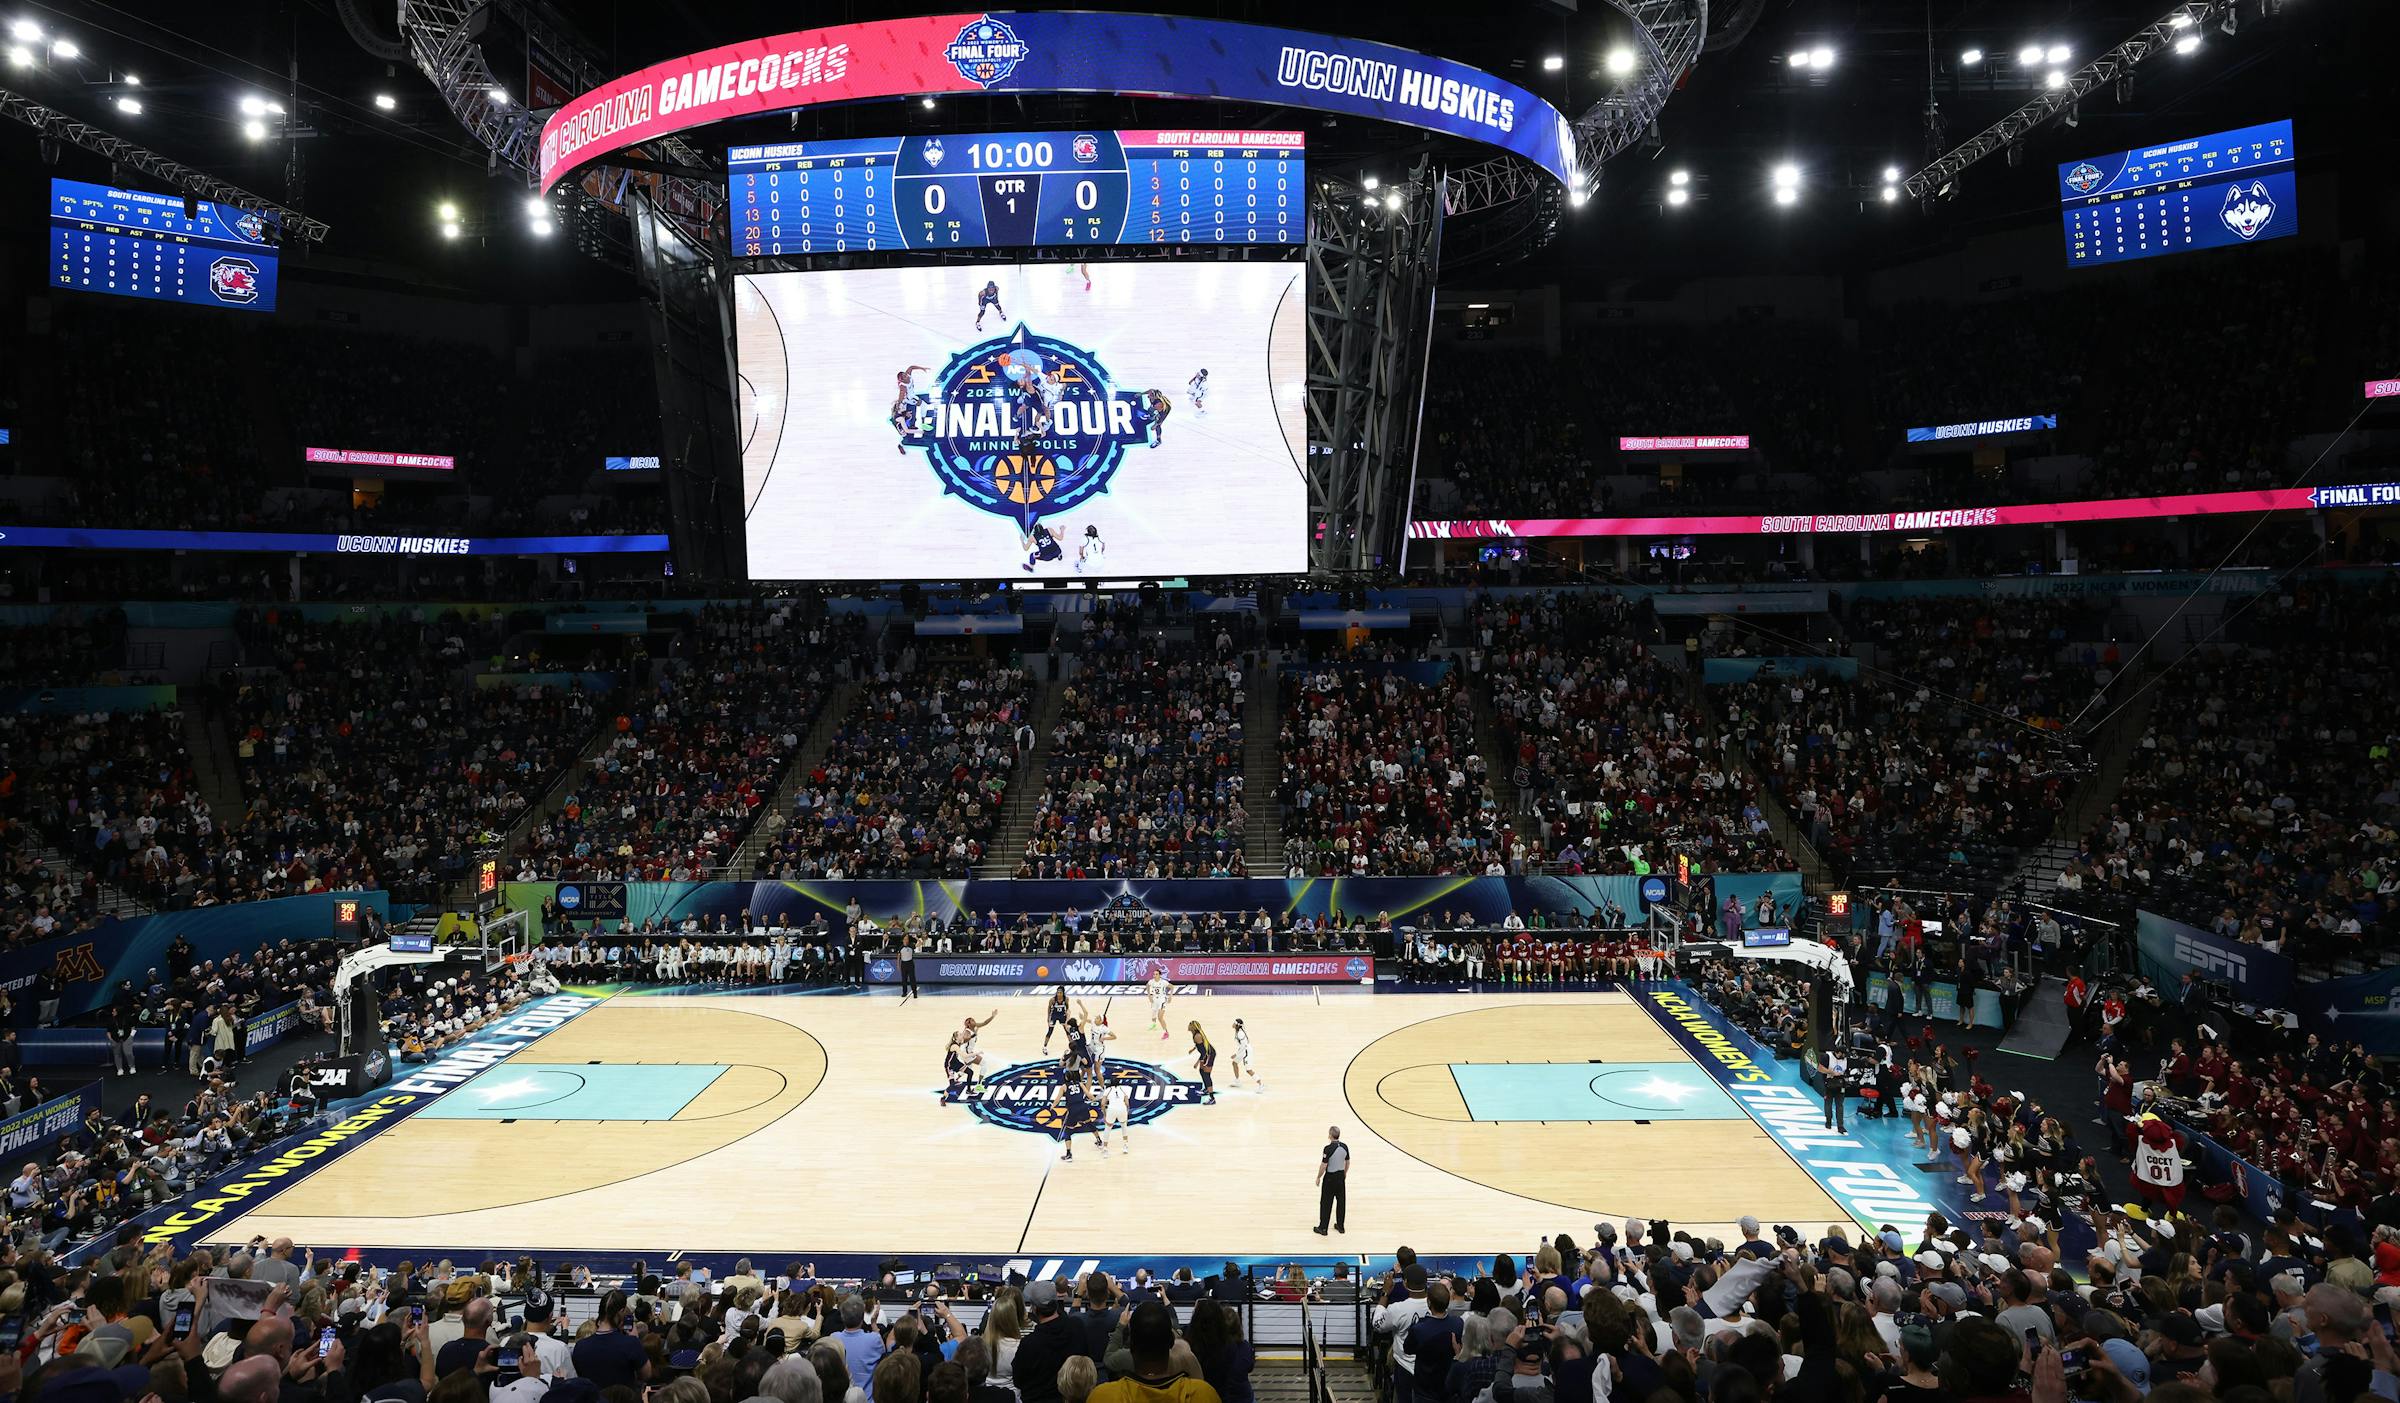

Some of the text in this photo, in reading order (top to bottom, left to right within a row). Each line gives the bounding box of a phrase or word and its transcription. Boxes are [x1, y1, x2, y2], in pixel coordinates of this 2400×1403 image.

[951, 44, 1020, 60] FINAL FOUR
[1276, 46, 1516, 132] UCONN HUSKIES
[560, 84, 652, 159] CAROLINA
[658, 43, 850, 116] GAMECOCKS
[1157, 133, 1302, 145] SOUTH CAROLINA GAMECOCKS
[732, 145, 804, 160] UCONN HUSKIES
[968, 141, 1053, 169] 10:00
[2143, 141, 2199, 159] UCONN HUSKIES
[2202, 151, 2218, 160] REB
[2227, 147, 2242, 156] AST
[2251, 143, 2262, 151] TO
[2270, 139, 2285, 147] STL
[766, 163, 781, 171] PTS
[798, 161, 813, 169] REB
[1152, 161, 1159, 173] 1
[747, 174, 755, 186] 3
[1152, 178, 1160, 190] 3
[107, 190, 166, 206] SOUTH CAROLINA
[747, 191, 755, 203] 5
[924, 180, 1098, 214] 0 QTR 0
[2088, 197, 2100, 205] PTS
[2133, 189, 2146, 197] AST
[2178, 181, 2192, 189] BLK
[1006, 198, 1016, 214] 1
[1152, 195, 1160, 207] 4
[60, 196, 77, 204] FG%
[200, 217, 213, 225] STL
[745, 210, 760, 222] 13
[1152, 211, 1160, 224] 5
[948, 221, 960, 229] FLS
[745, 227, 760, 239] 20
[926, 230, 960, 243] 4 0
[1066, 227, 1099, 239] 4 0
[1149, 230, 1164, 241] 12
[746, 244, 761, 256] 35
[1935, 418, 2033, 439] UCONN HUSKIES
[1626, 438, 1746, 448] SOUTH CAROLINA GAMECOCKS
[314, 450, 454, 467] SOUTH CAROLINA GAMECOCKS
[2320, 488, 2368, 504] FINAL
[1761, 508, 1998, 533] SOUTH CAROLINA GAMECOCKS
[337, 535, 470, 554] UCONN HUSKIES
[481, 873, 494, 891] 30
[1831, 903, 1844, 914] 30
[341, 911, 353, 922] 30
[1776, 933, 1787, 941] ALL
[419, 940, 430, 948] ALL
[2174, 934, 2247, 984] ESPN
[940, 964, 1024, 977] UCONN HUSKIES
[1179, 963, 1338, 976] SOUTH CAROLINA GAMECOCKS
[25, 973, 38, 986] BY
[2365, 996, 2386, 1005] MSP
[247, 1015, 276, 1032] 2022 NCAA
[246, 1025, 274, 1047] FINAL
[1071, 1031, 1080, 1040] 20
[1648, 992, 1702, 1021] NCAA
[1681, 1021, 1773, 1082] WOMEN'S
[1729, 1083, 1864, 1152] FINAL
[1068, 1085, 1080, 1095] 35
[1, 1095, 81, 1136] 2022 NCAA WOMEN'S
[143, 1180, 271, 1244] NCAA
[244, 1094, 417, 1179] WOMEN'S
[391, 1041, 525, 1096] FINAL
[493, 995, 602, 1037] FOUR
[0, 1104, 80, 1155] FINAL FOUR
[2147, 1156, 2173, 1166] COCKY
[2150, 1166, 2171, 1182] 01
